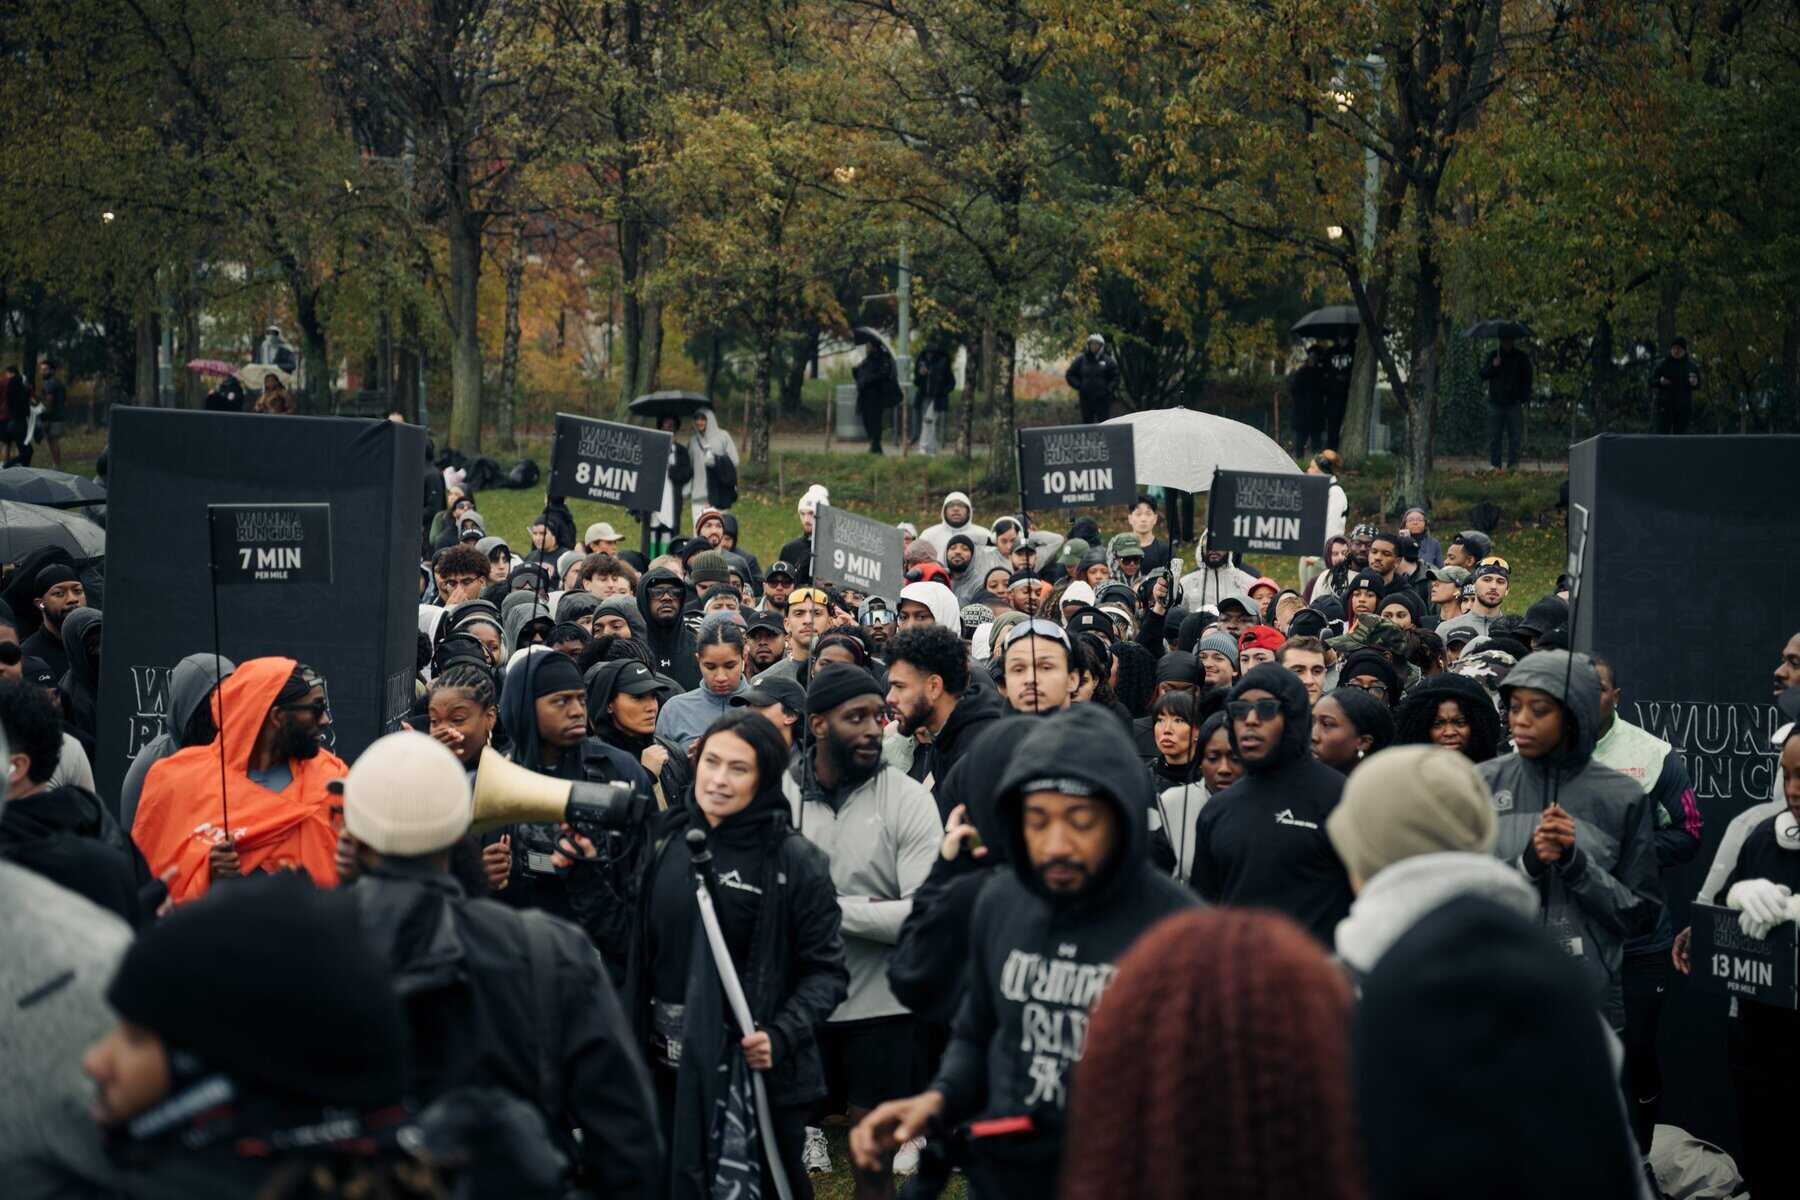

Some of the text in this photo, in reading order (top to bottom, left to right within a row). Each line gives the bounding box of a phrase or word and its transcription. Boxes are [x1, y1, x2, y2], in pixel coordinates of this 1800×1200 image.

[578, 440, 607, 459] RUN
[1043, 447, 1074, 466] RUN
[575, 462, 639, 493] 8 MIN
[1041, 467, 1113, 494] 10 MIN
[588, 487, 621, 501] PER MILE
[1062, 493, 1096, 503] PER MILE
[1235, 492, 1266, 509] RUN
[236, 527, 267, 542] RUN
[1232, 515, 1301, 541] 11 MIN
[1248, 539, 1282, 550] PER MILE
[239, 547, 302, 569] 7 MIN
[833, 549, 882, 582] 9 MIN
[255, 571, 288, 579] PER MILE
[1634, 701, 1781, 755] WUN
[1712, 953, 1773, 987] 13 MIN
[1727, 981, 1740, 991] PER
